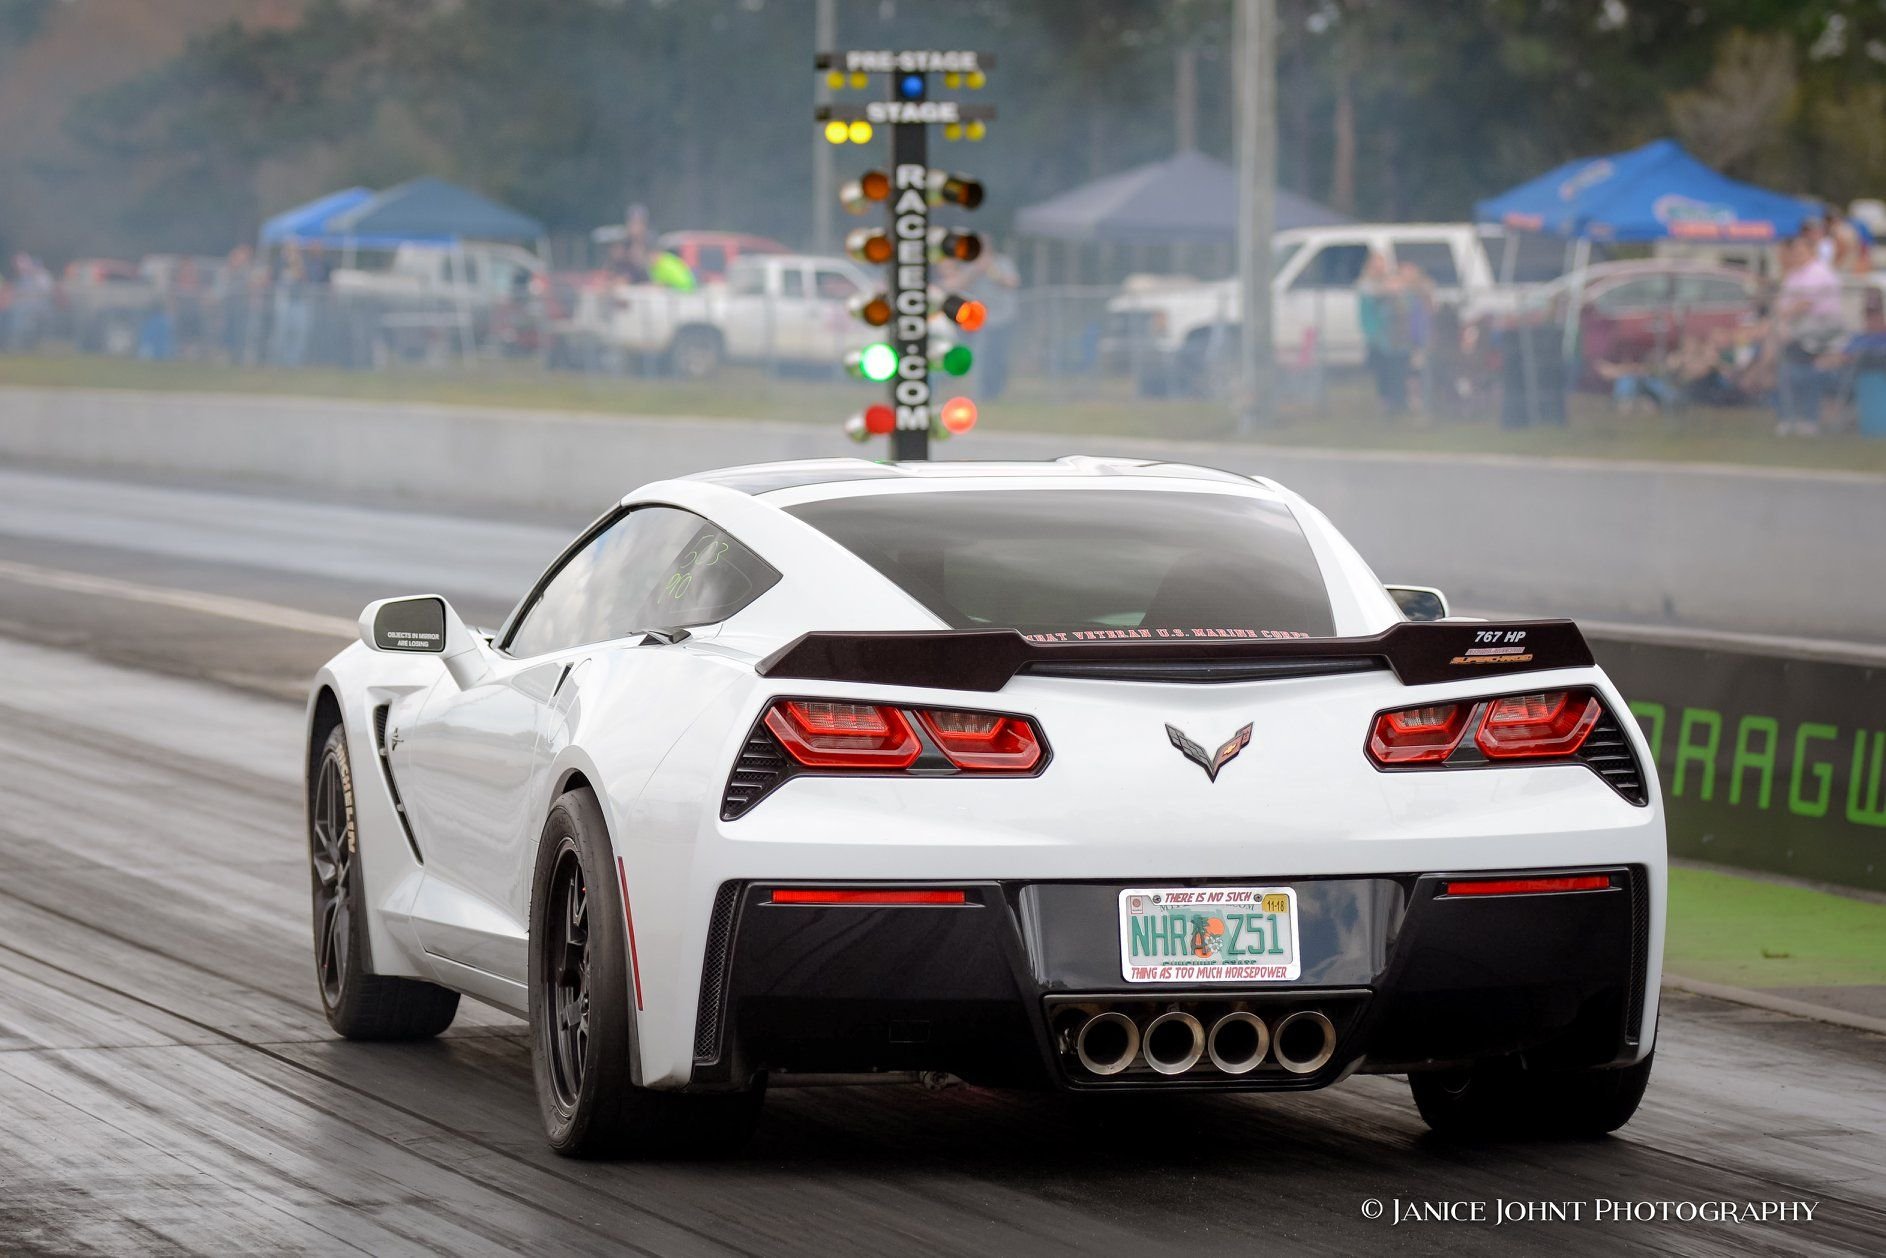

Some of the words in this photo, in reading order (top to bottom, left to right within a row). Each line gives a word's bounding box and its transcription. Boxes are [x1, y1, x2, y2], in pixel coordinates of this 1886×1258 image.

[846, 50, 978, 72] PRE-STAGE
[866, 101, 960, 124] STAGE
[896, 164, 929, 431] RACEECD.COM
[1025, 632, 1068, 642] BAT
[1073, 629, 1152, 640] VETERAN
[1156, 628, 1189, 638] U.S.
[1191, 628, 1258, 638] MARINE
[1474, 630, 1503, 643] 767
[1504, 630, 1527, 643] HP
[1165, 892, 1193, 903] THERE
[1195, 892, 1207, 903] IS
[1209, 892, 1223, 903] NO
[1225, 891, 1252, 903] SUCH
[1267, 899, 1285, 912] 11-18
[1227, 914, 1284, 955] Z51
[1131, 966, 1158, 980] THING
[1159, 967, 1172, 980] AS
[1175, 967, 1194, 980] TOO
[1196, 966, 1222, 980] MUCH
[1225, 966, 1288, 979] HORSEPOWER
